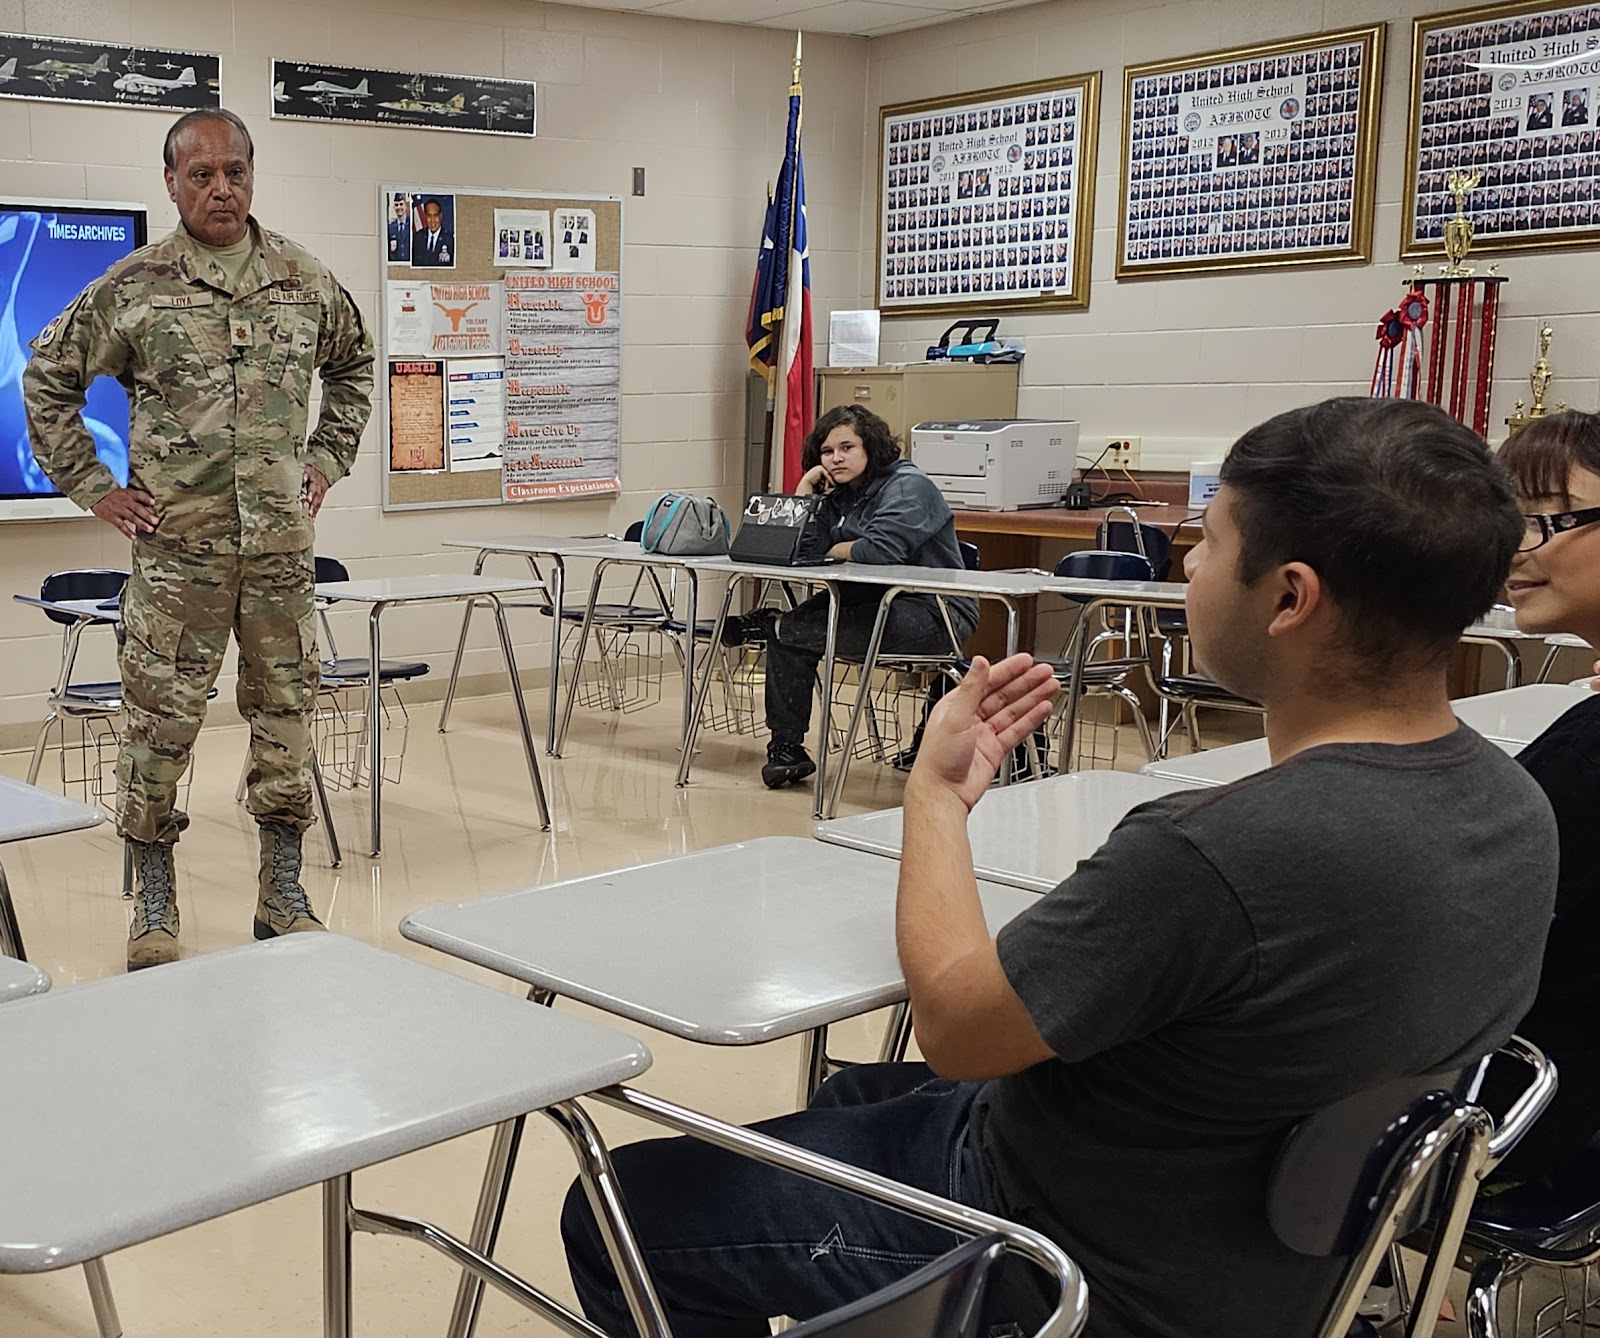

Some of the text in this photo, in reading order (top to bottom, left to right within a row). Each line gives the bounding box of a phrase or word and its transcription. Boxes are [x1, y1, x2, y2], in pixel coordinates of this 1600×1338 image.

[1489, 45, 1537, 64] United
[1542, 38, 1580, 57] High
[1191, 82, 1294, 107] United High School
[1494, 97, 1522, 110] 2013
[938, 132, 1018, 152] United High School
[1192, 137, 1214, 149] 2012
[48, 223, 126, 241] TIMES ARCHIVES
[505, 275, 617, 290] UNITED HIGH SCHOOL
[282, 291, 295, 301] AIR
[296, 290, 320, 301] FORCE
[468, 285, 491, 300] SCHOOL
[171, 296, 192, 307] LOYA
[395, 362, 437, 374] UNITED
[507, 378, 572, 398] Responsible
[507, 420, 581, 438] Never Give Up
[510, 481, 615, 496] Classroom Expectations
